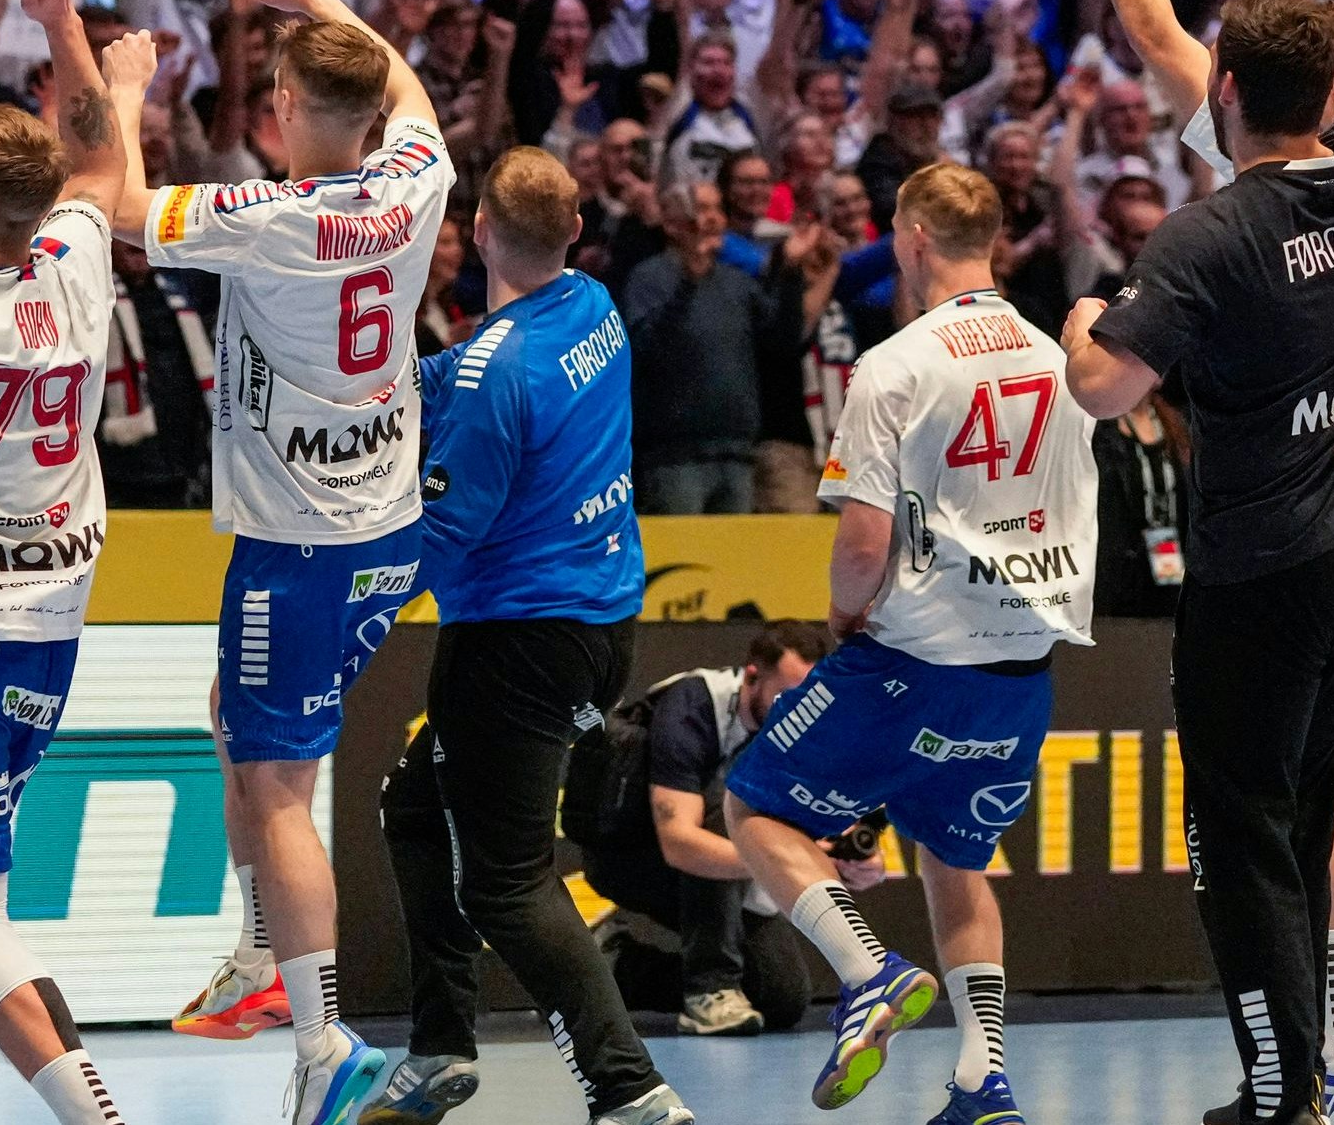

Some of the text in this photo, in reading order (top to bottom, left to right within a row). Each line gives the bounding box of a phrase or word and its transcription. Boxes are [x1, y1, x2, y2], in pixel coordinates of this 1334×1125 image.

[316, 203, 413, 261] MORTENSEN
[14, 300, 59, 350] HORN
[338, 264, 395, 376] 6
[559, 309, 625, 392] FØROYAR
[945, 371, 1058, 482] 47
[424, 475, 447, 493] sms
[53, 505, 69, 523] 24
[984, 516, 1027, 535] SPORT
[968, 545, 1079, 586] MOWI
[883, 679, 909, 698] 47
[947, 823, 1002, 845] MAZ
